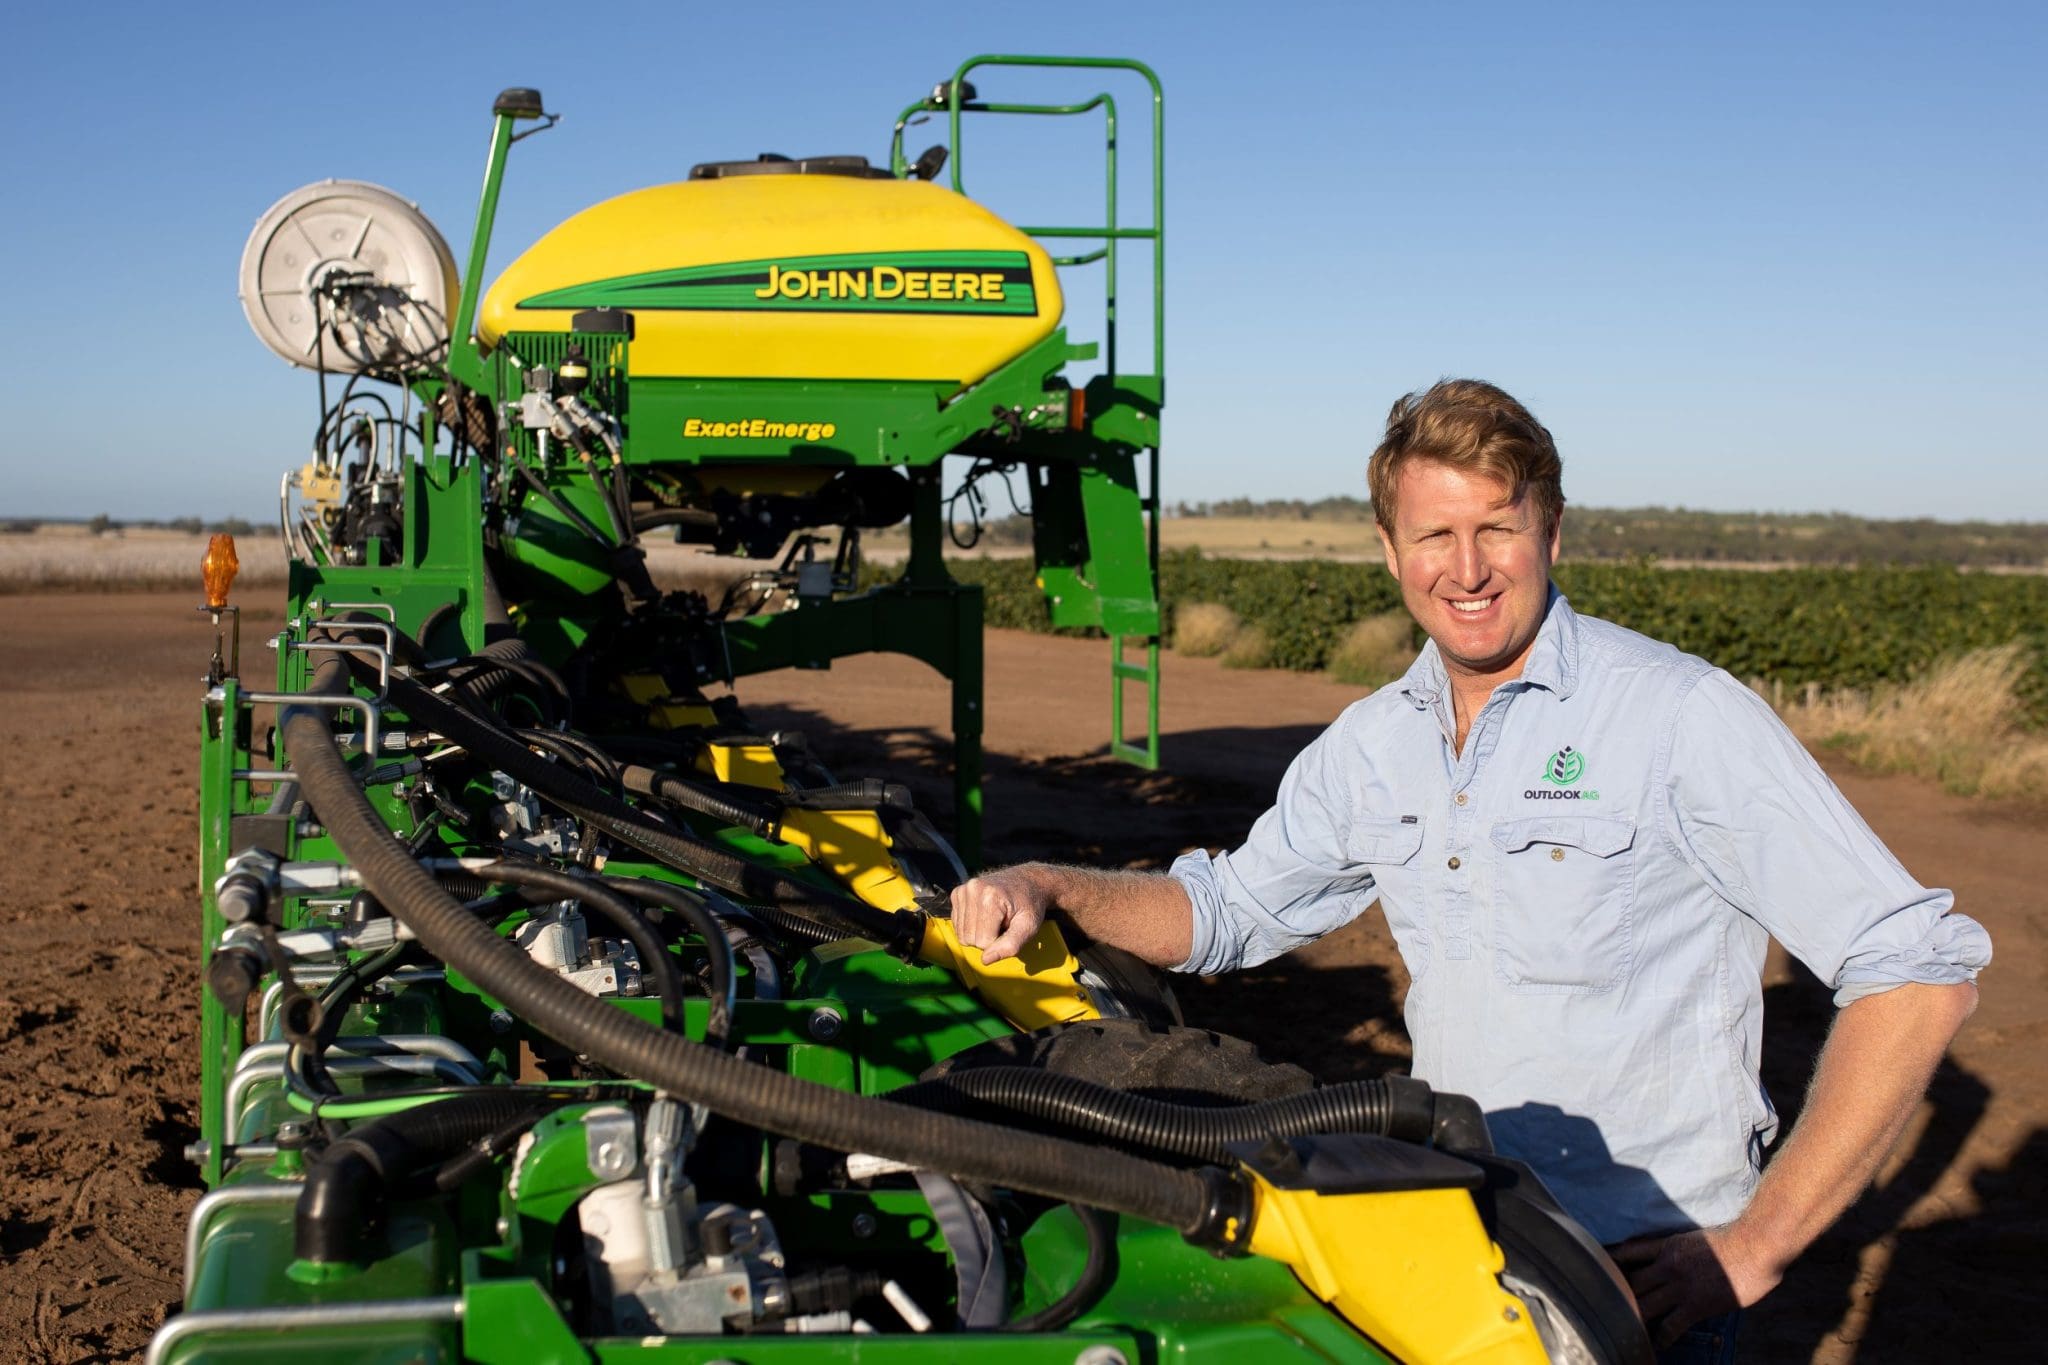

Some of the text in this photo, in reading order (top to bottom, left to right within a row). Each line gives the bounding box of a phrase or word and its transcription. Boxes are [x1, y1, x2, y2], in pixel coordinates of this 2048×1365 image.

[755, 265, 1005, 300] JOHN DEERE
[684, 418, 836, 442] ExactEmerge
